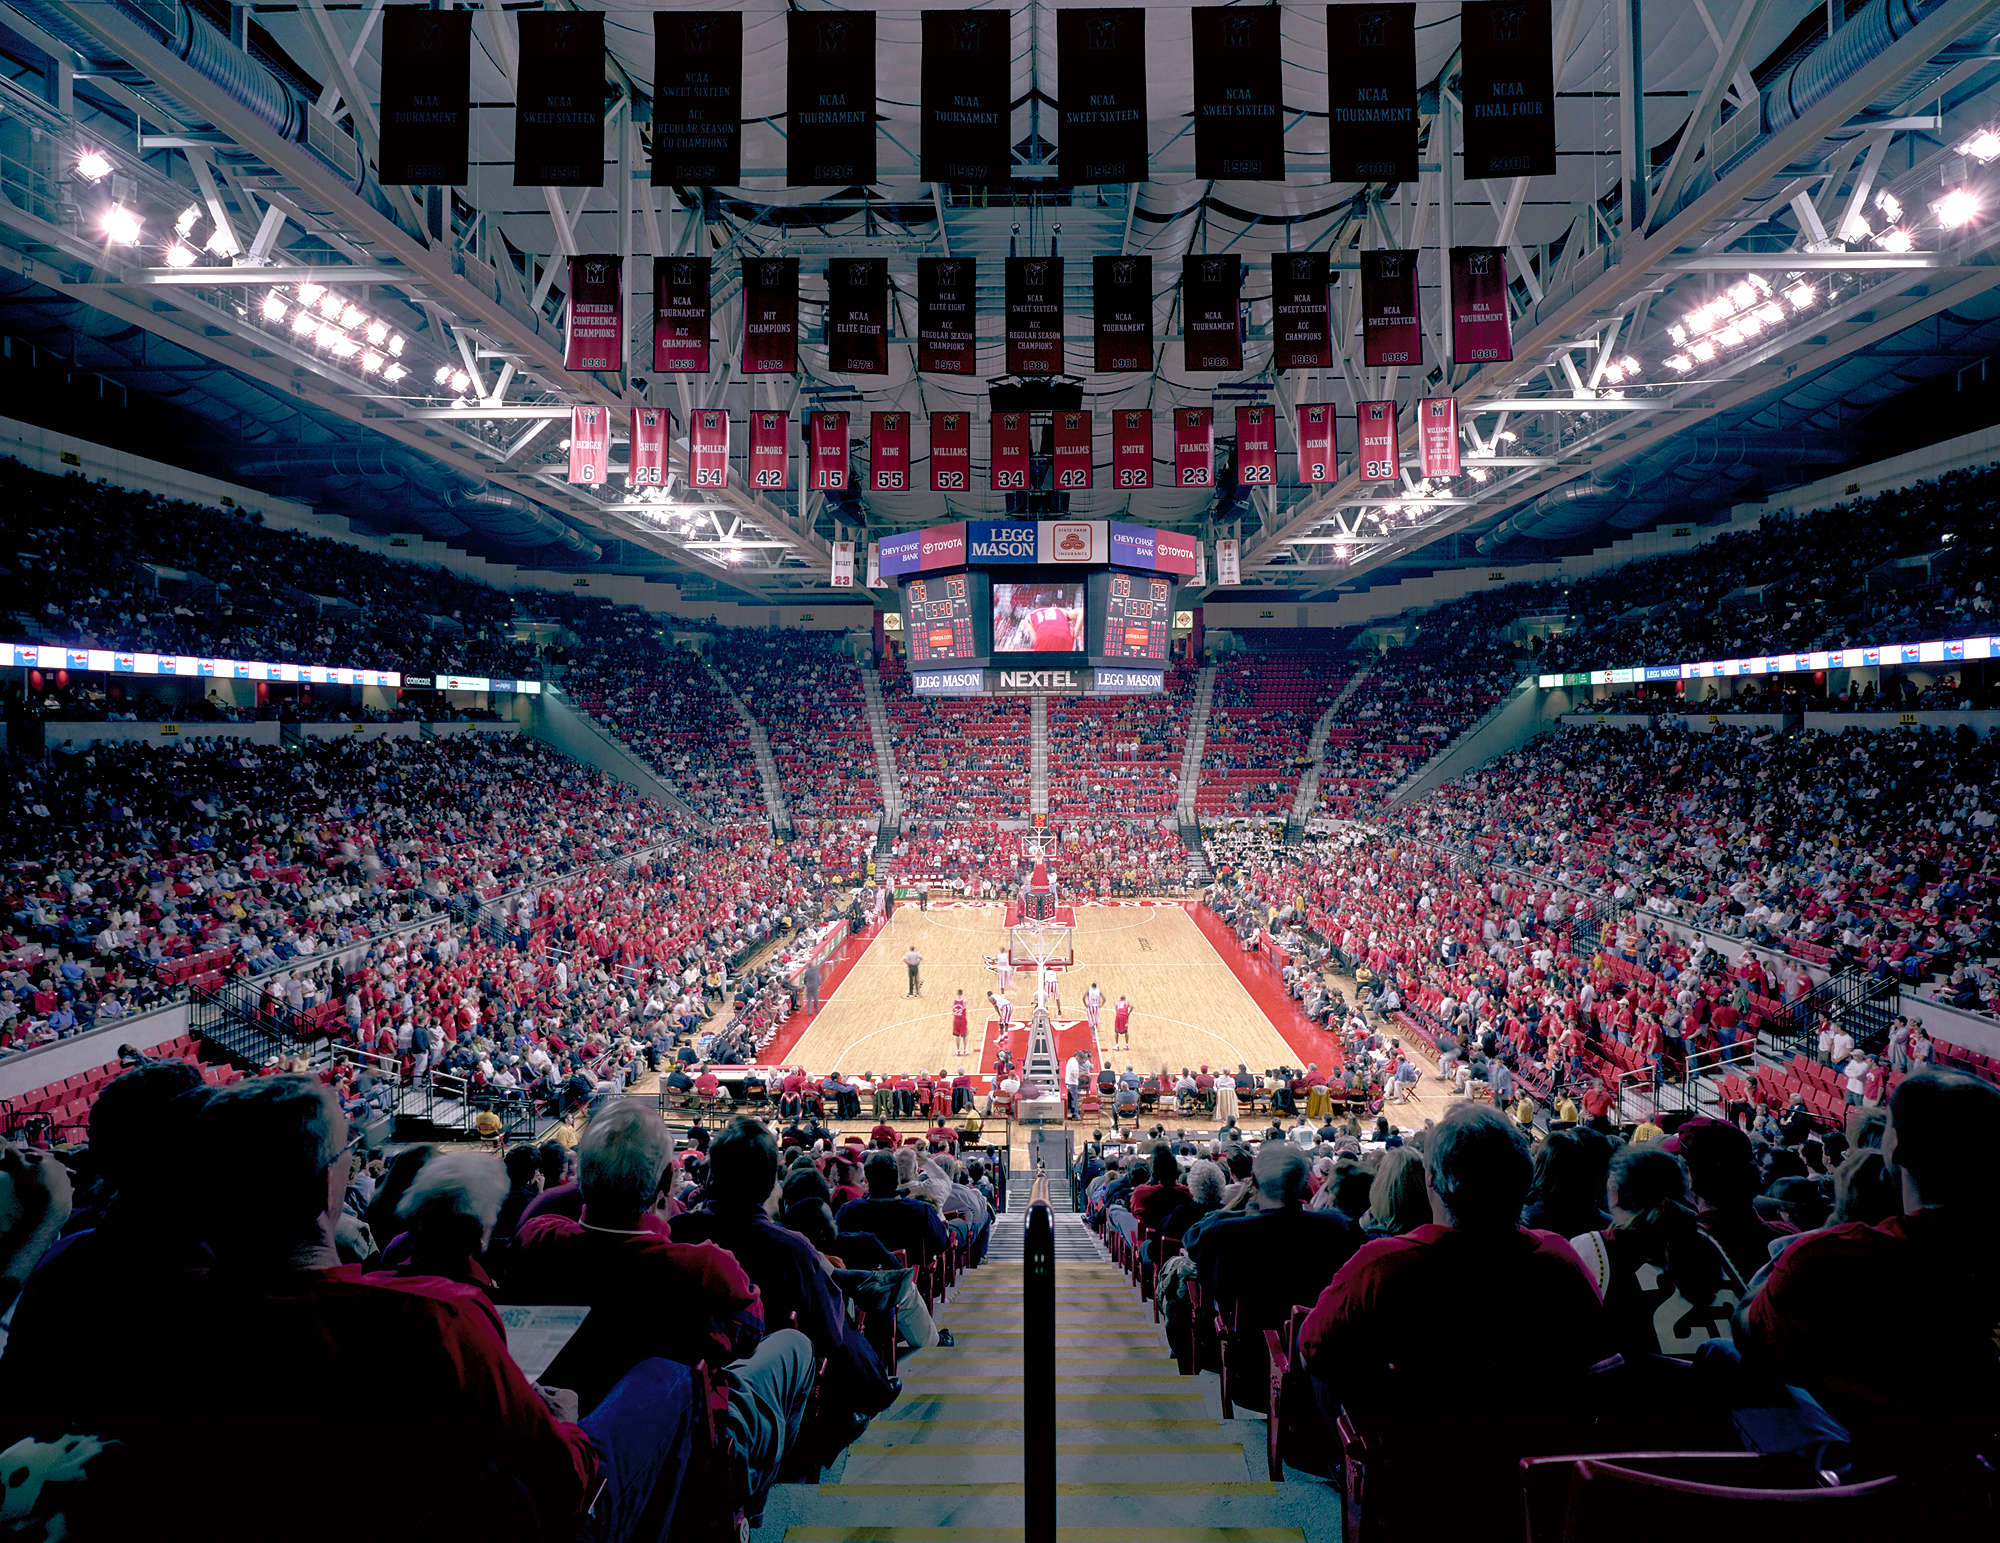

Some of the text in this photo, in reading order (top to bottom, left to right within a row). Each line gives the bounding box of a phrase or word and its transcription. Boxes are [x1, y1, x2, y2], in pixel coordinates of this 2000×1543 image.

[1225, 87, 1251, 99] NCAA
[1357, 87, 1388, 101] NCAA
[1491, 82, 1523, 96] NCAA
[1089, 95, 1115, 105] NCAA
[1202, 104, 1275, 116] SWEET SIXTEEN
[1335, 108, 1411, 121] TOURNAMENT
[1474, 101, 1542, 118] FINAL FOUR
[798, 111, 866, 124] TOURNAMENT
[935, 110, 999, 124] TOURNAMENT
[1066, 109, 1139, 123] SWEET SIXTEEN
[673, 297, 692, 306] NCAA
[939, 292, 956, 301] NCAA
[1026, 294, 1044, 303] NCAA
[1294, 294, 1311, 303] NCAA
[576, 303, 614, 313] SOUTHERN
[1278, 304, 1326, 314] SWEET SIXTEEN
[1383, 306, 1400, 315] NCAA
[1472, 303, 1489, 312] NCAA
[659, 308, 705, 318] TOURNAMENT
[763, 311, 776, 321] NIT
[849, 311, 869, 321] NCAA
[1115, 312, 1132, 321] NCAA
[1204, 311, 1222, 320] NCAA
[1460, 313, 1503, 323] TOURNAMENT
[572, 315, 618, 326] CONFERENCE
[941, 321, 953, 329] ACC
[1029, 320, 1041, 329] ACC
[1297, 321, 1309, 330] ACC
[1368, 316, 1416, 326] SWEET SIXTEEN
[748, 323, 791, 334] CHAMPIONS
[837, 323, 881, 335] ELITE EIGHT
[1102, 322, 1145, 332] TOURNAMENT
[1192, 321, 1235, 331] TOURNAMENT
[573, 328, 615, 338] CHAMPIONS
[676, 328, 689, 337] ACC
[921, 330, 973, 341] REGULAR SEASON
[1009, 331, 1060, 340] REGULAR SEASON
[1285, 332, 1321, 342] CHAMPIONS
[662, 338, 702, 349] CHAMPIONS
[929, 342, 965, 351] CHAMPIONS
[1017, 341, 1053, 350] CHAMPIONS
[582, 357, 607, 368] 1931
[758, 359, 783, 370] 1972
[1244, 441, 1268, 451] BOOTH
[1306, 439, 1329, 449] DIXON
[1364, 436, 1392, 446] BAXTER
[639, 442, 659, 452] SHUE
[755, 446, 783, 455] ELMORE
[818, 446, 840, 456] LUCAS
[882, 447, 899, 457] KING
[933, 447, 967, 457] WILLIAMS
[1002, 446, 1019, 456] BIAS
[1055, 445, 1090, 455] WILLIAMS
[1121, 445, 1144, 454] SMITH
[1180, 443, 1209, 453] FRANCIS
[582, 464, 595, 481] 6
[636, 466, 662, 482] 25
[1244, 465, 1271, 482] 22
[1311, 463, 1325, 480] 3
[1366, 460, 1393, 478] 35
[696, 468, 722, 486] 54
[755, 469, 783, 487] 42
[818, 470, 842, 487] 15
[877, 470, 903, 488] 55
[937, 471, 964, 488] 52
[998, 470, 1024, 487] 34
[1060, 469, 1086, 487] 42
[1120, 469, 1147, 486] 32
[1182, 467, 1209, 485] 23
[990, 528, 1034, 542] LEGG
[1113, 533, 1154, 547] CHEVY CHASE
[881, 542, 920, 556] CHEVY CHASE
[933, 538, 963, 552] TOYOTA
[971, 542, 1035, 556] MASON
[902, 552, 919, 562] BANK
[1136, 548, 1154, 558] BANK
[1167, 546, 1194, 560] TOYOTA
[835, 576, 850, 585] 23
[1646, 668, 1680, 679] LEGG MASON
[916, 673, 980, 688] LEGG MASON
[999, 671, 1077, 687] NEXTEL
[1097, 672, 1161, 687] LEGG MASON
